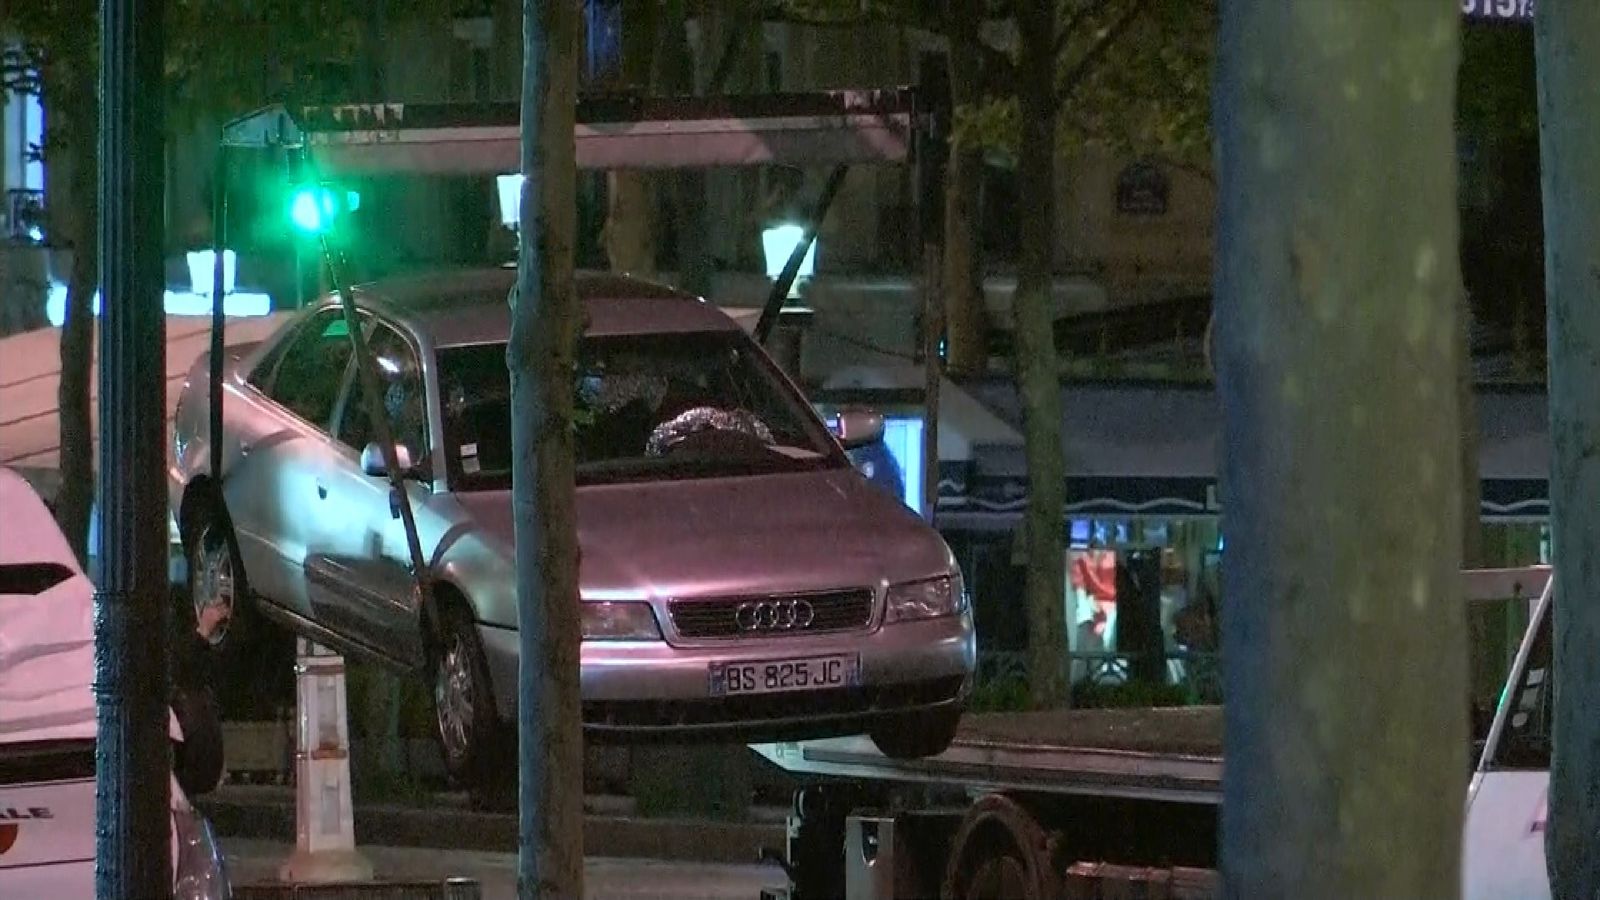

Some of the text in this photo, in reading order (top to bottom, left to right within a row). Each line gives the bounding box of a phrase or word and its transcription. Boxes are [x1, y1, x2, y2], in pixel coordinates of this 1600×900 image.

[727, 660, 841, 690] BS 825 JC
